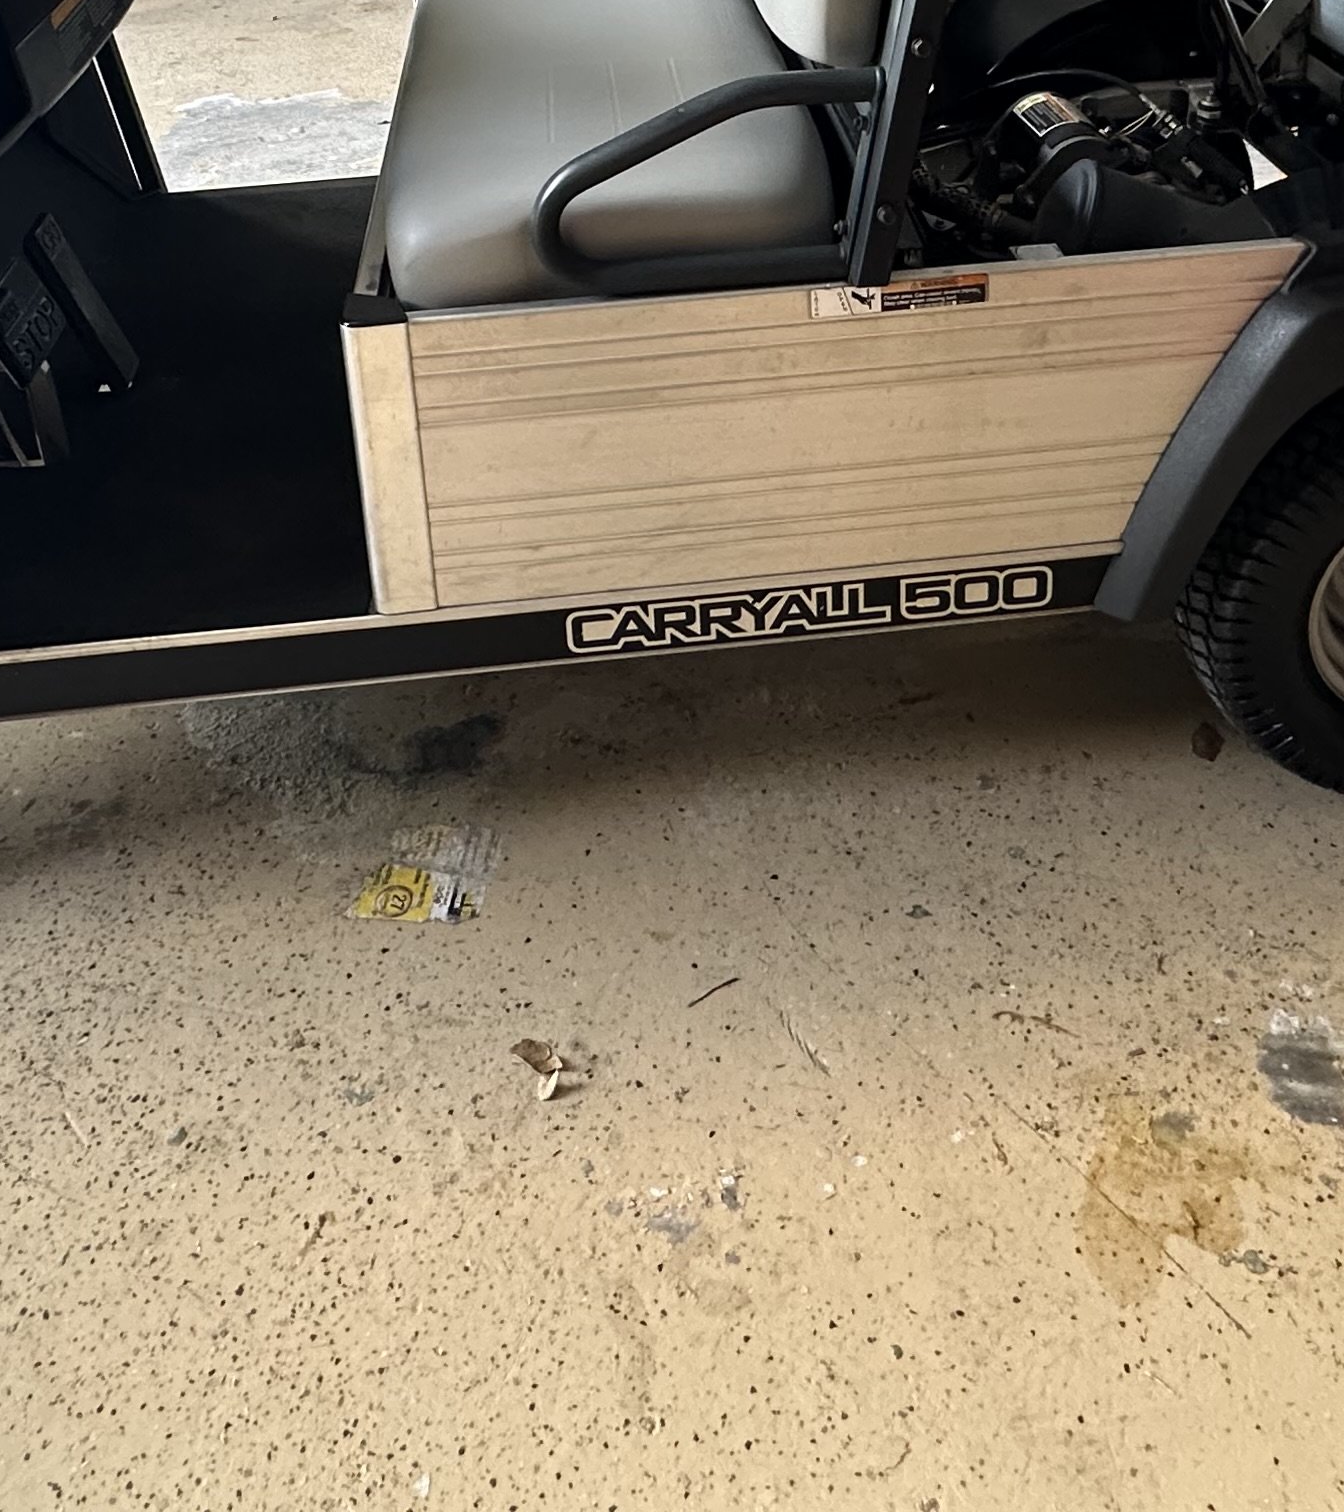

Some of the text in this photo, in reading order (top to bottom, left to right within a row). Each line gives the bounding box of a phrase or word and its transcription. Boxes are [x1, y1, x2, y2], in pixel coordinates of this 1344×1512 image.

[15, 296, 58, 369] STOP
[566, 565, 1054, 654] CARRYALL 500
